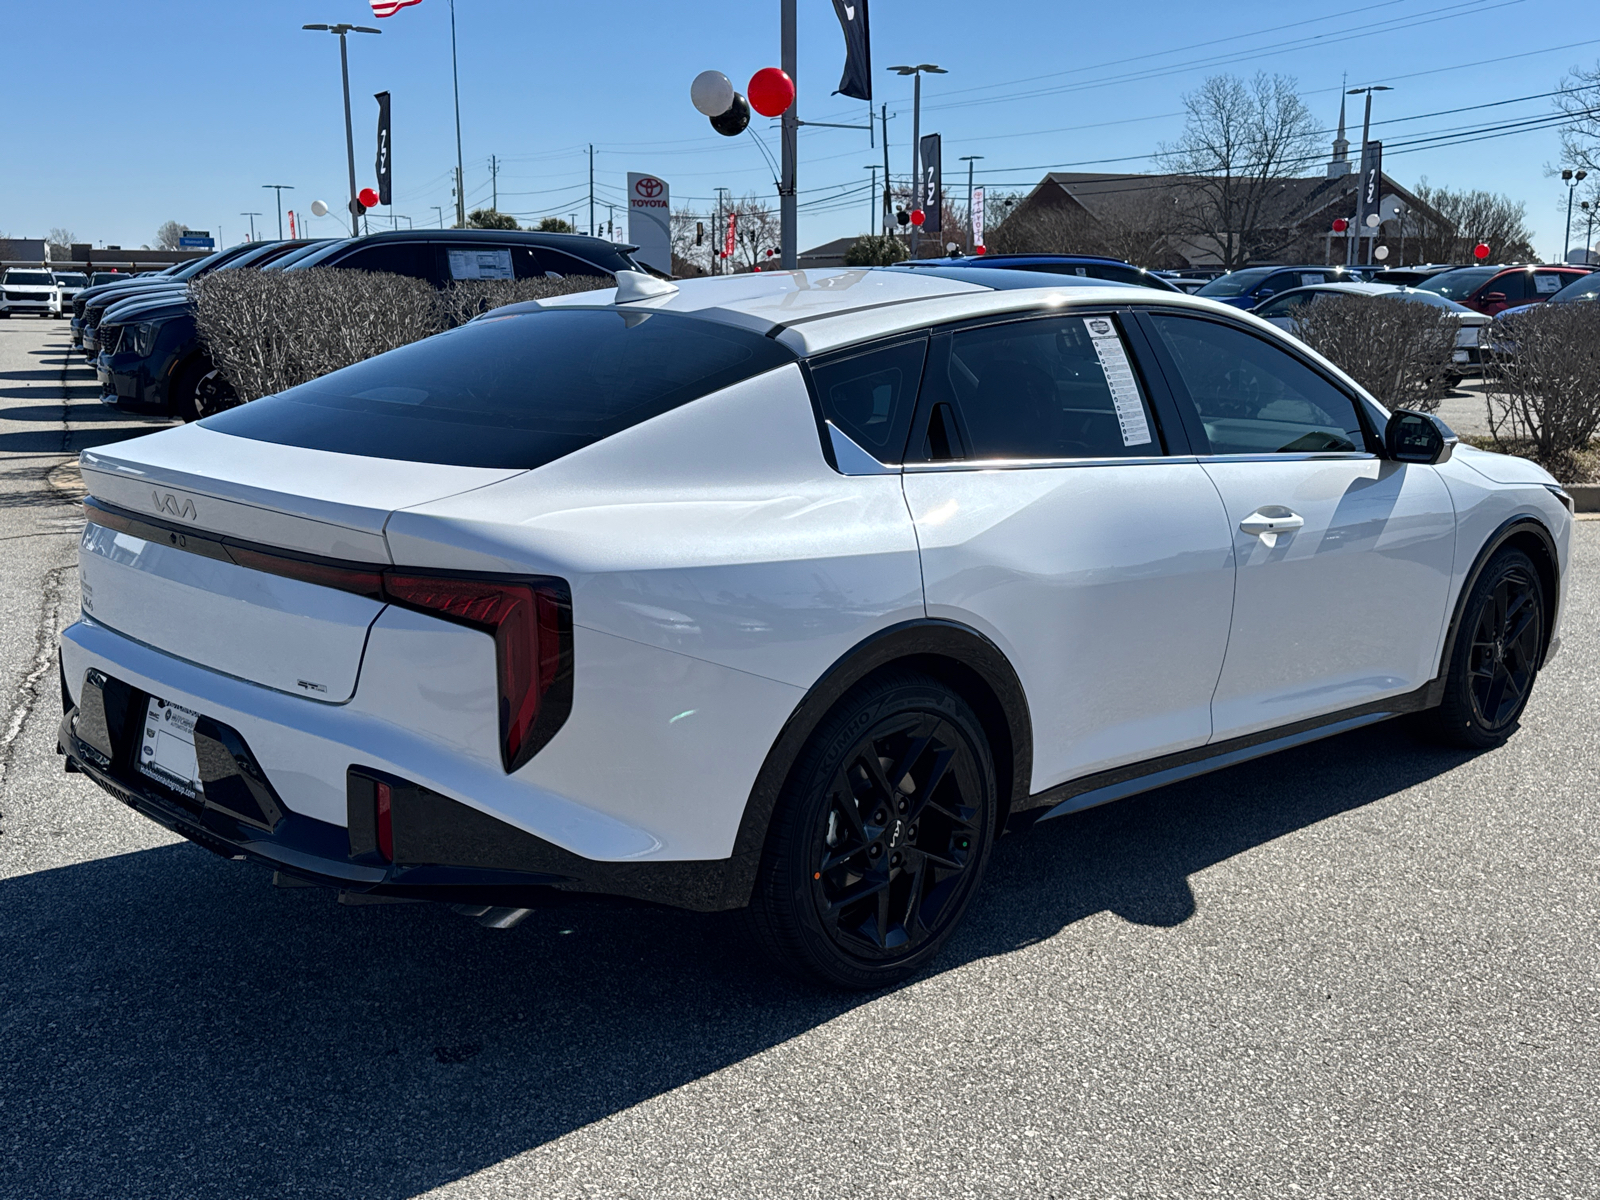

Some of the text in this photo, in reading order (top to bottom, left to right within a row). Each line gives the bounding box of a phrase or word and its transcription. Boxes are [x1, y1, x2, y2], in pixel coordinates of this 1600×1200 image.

[631, 199, 668, 208] TOYOTA
[152, 490, 197, 520] KIA
[820, 712, 870, 775] KUMHO
